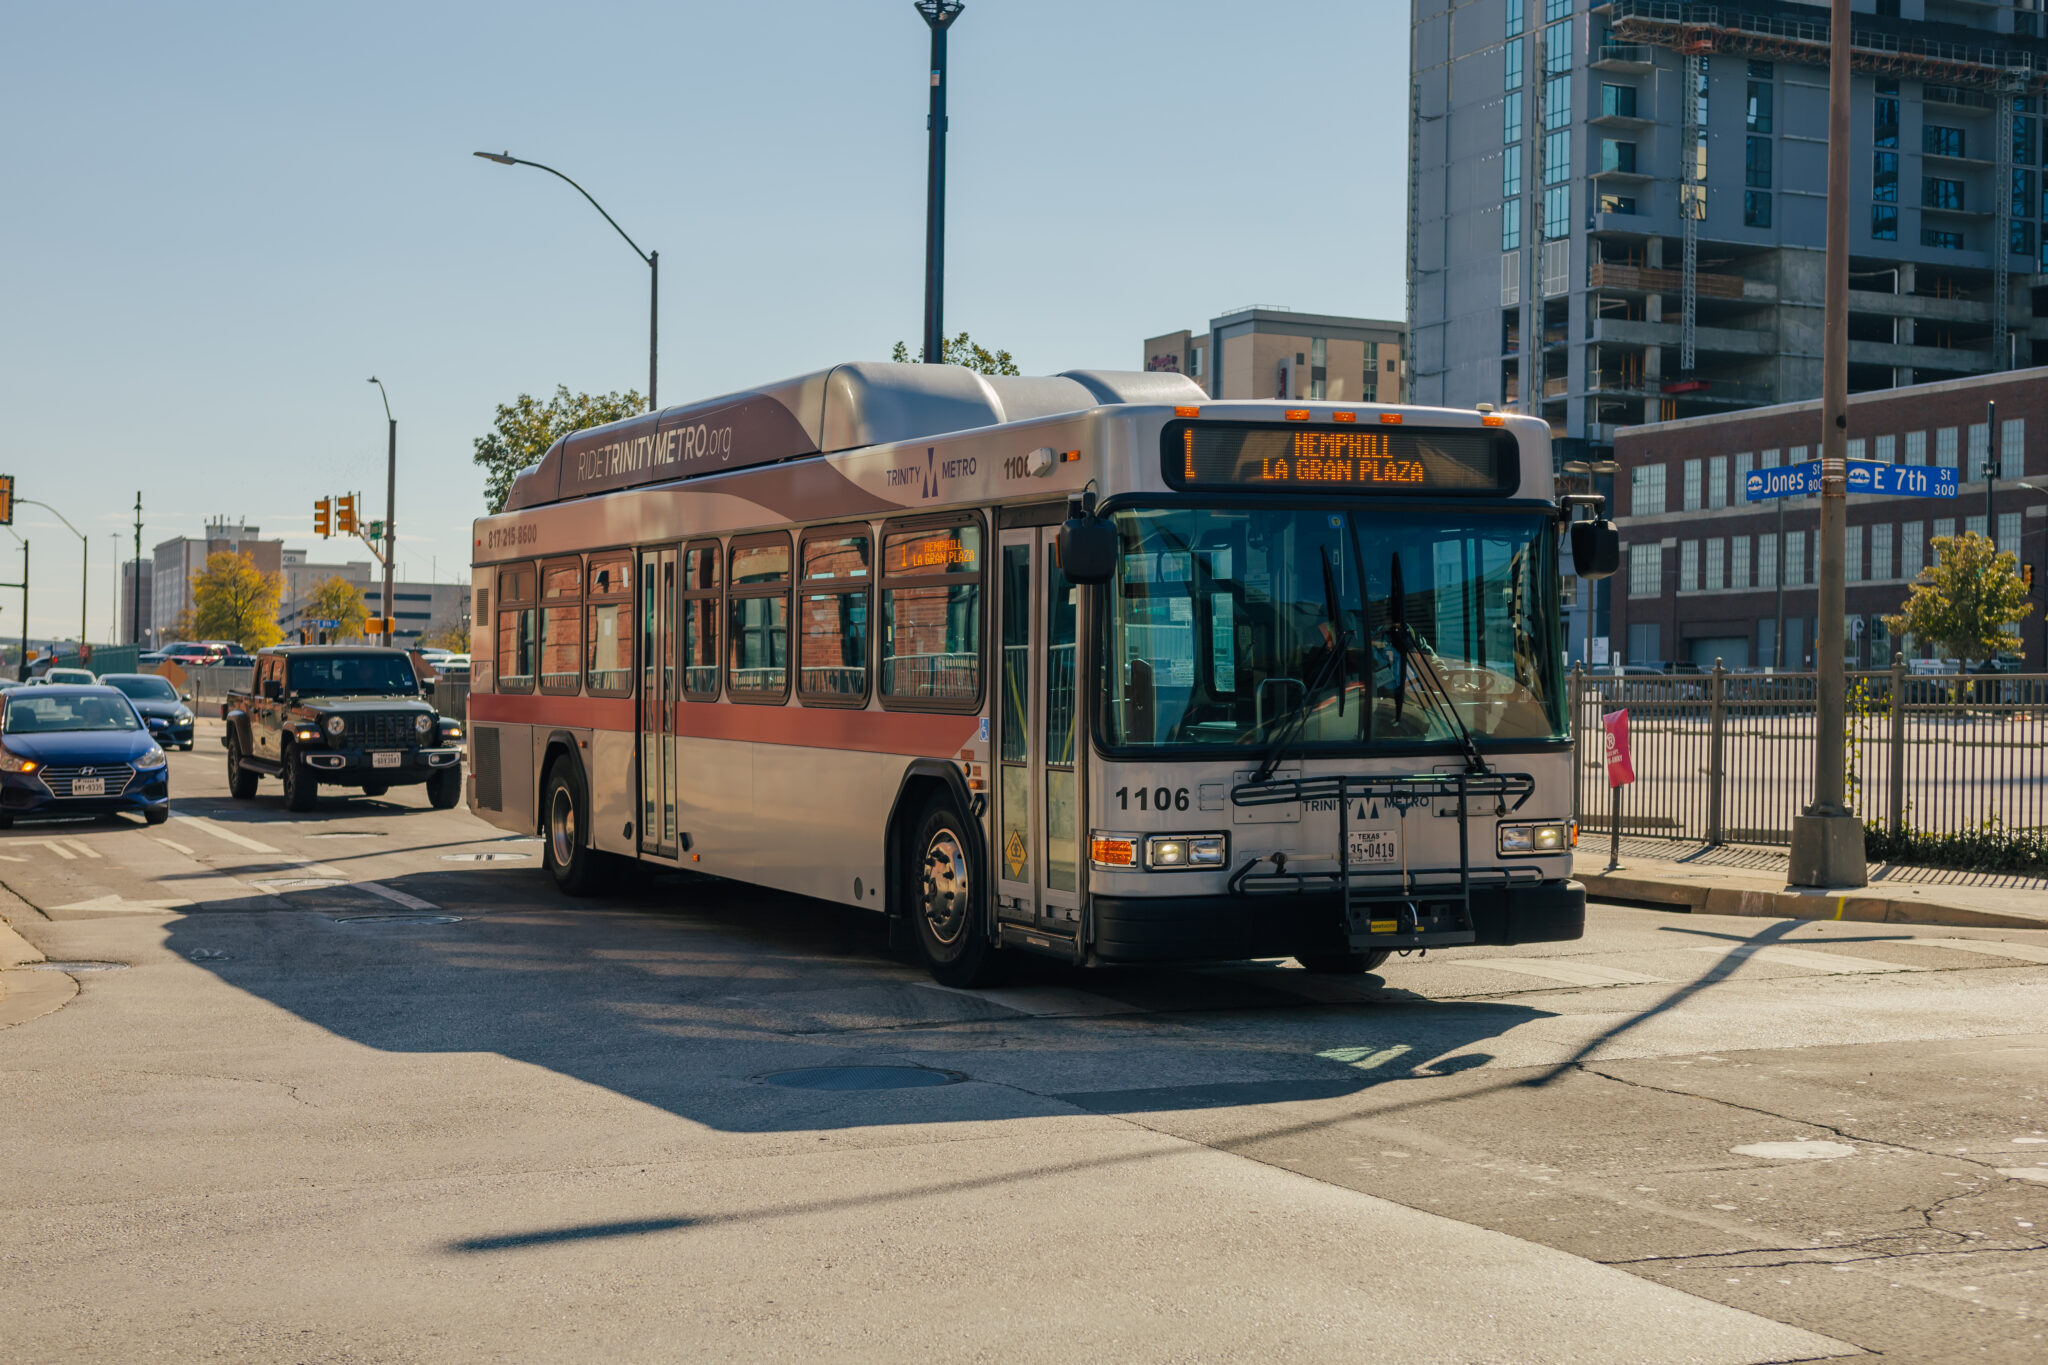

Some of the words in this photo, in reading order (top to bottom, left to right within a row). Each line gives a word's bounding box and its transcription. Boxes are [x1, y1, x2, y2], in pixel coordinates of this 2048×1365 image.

[577, 423, 732, 482] RIDETRINITYMETRO.org
[1183, 429, 1196, 479] 1
[1294, 433, 1393, 458] HEMPHILL
[886, 466, 921, 487] TRINITY
[942, 457, 977, 479] METRO
[1262, 458, 1289, 480] LA
[1295, 459, 1352, 481] GRAN
[1359, 460, 1424, 483] PLAZA
[1812, 463, 1821, 476] St
[1874, 467, 1885, 490] E
[1895, 468, 1927, 492] 7th
[1940, 469, 1951, 481] St
[1763, 472, 1804, 494] Jones
[1934, 484, 1955, 497] 300
[913, 554, 923, 567] LA
[925, 551, 946, 566] GRAN
[948, 549, 975, 564] PLAZA
[924, 539, 962, 553] HEMPHILL
[1115, 786, 1190, 811] 1106
[1303, 799, 1354, 812] TRINIY
